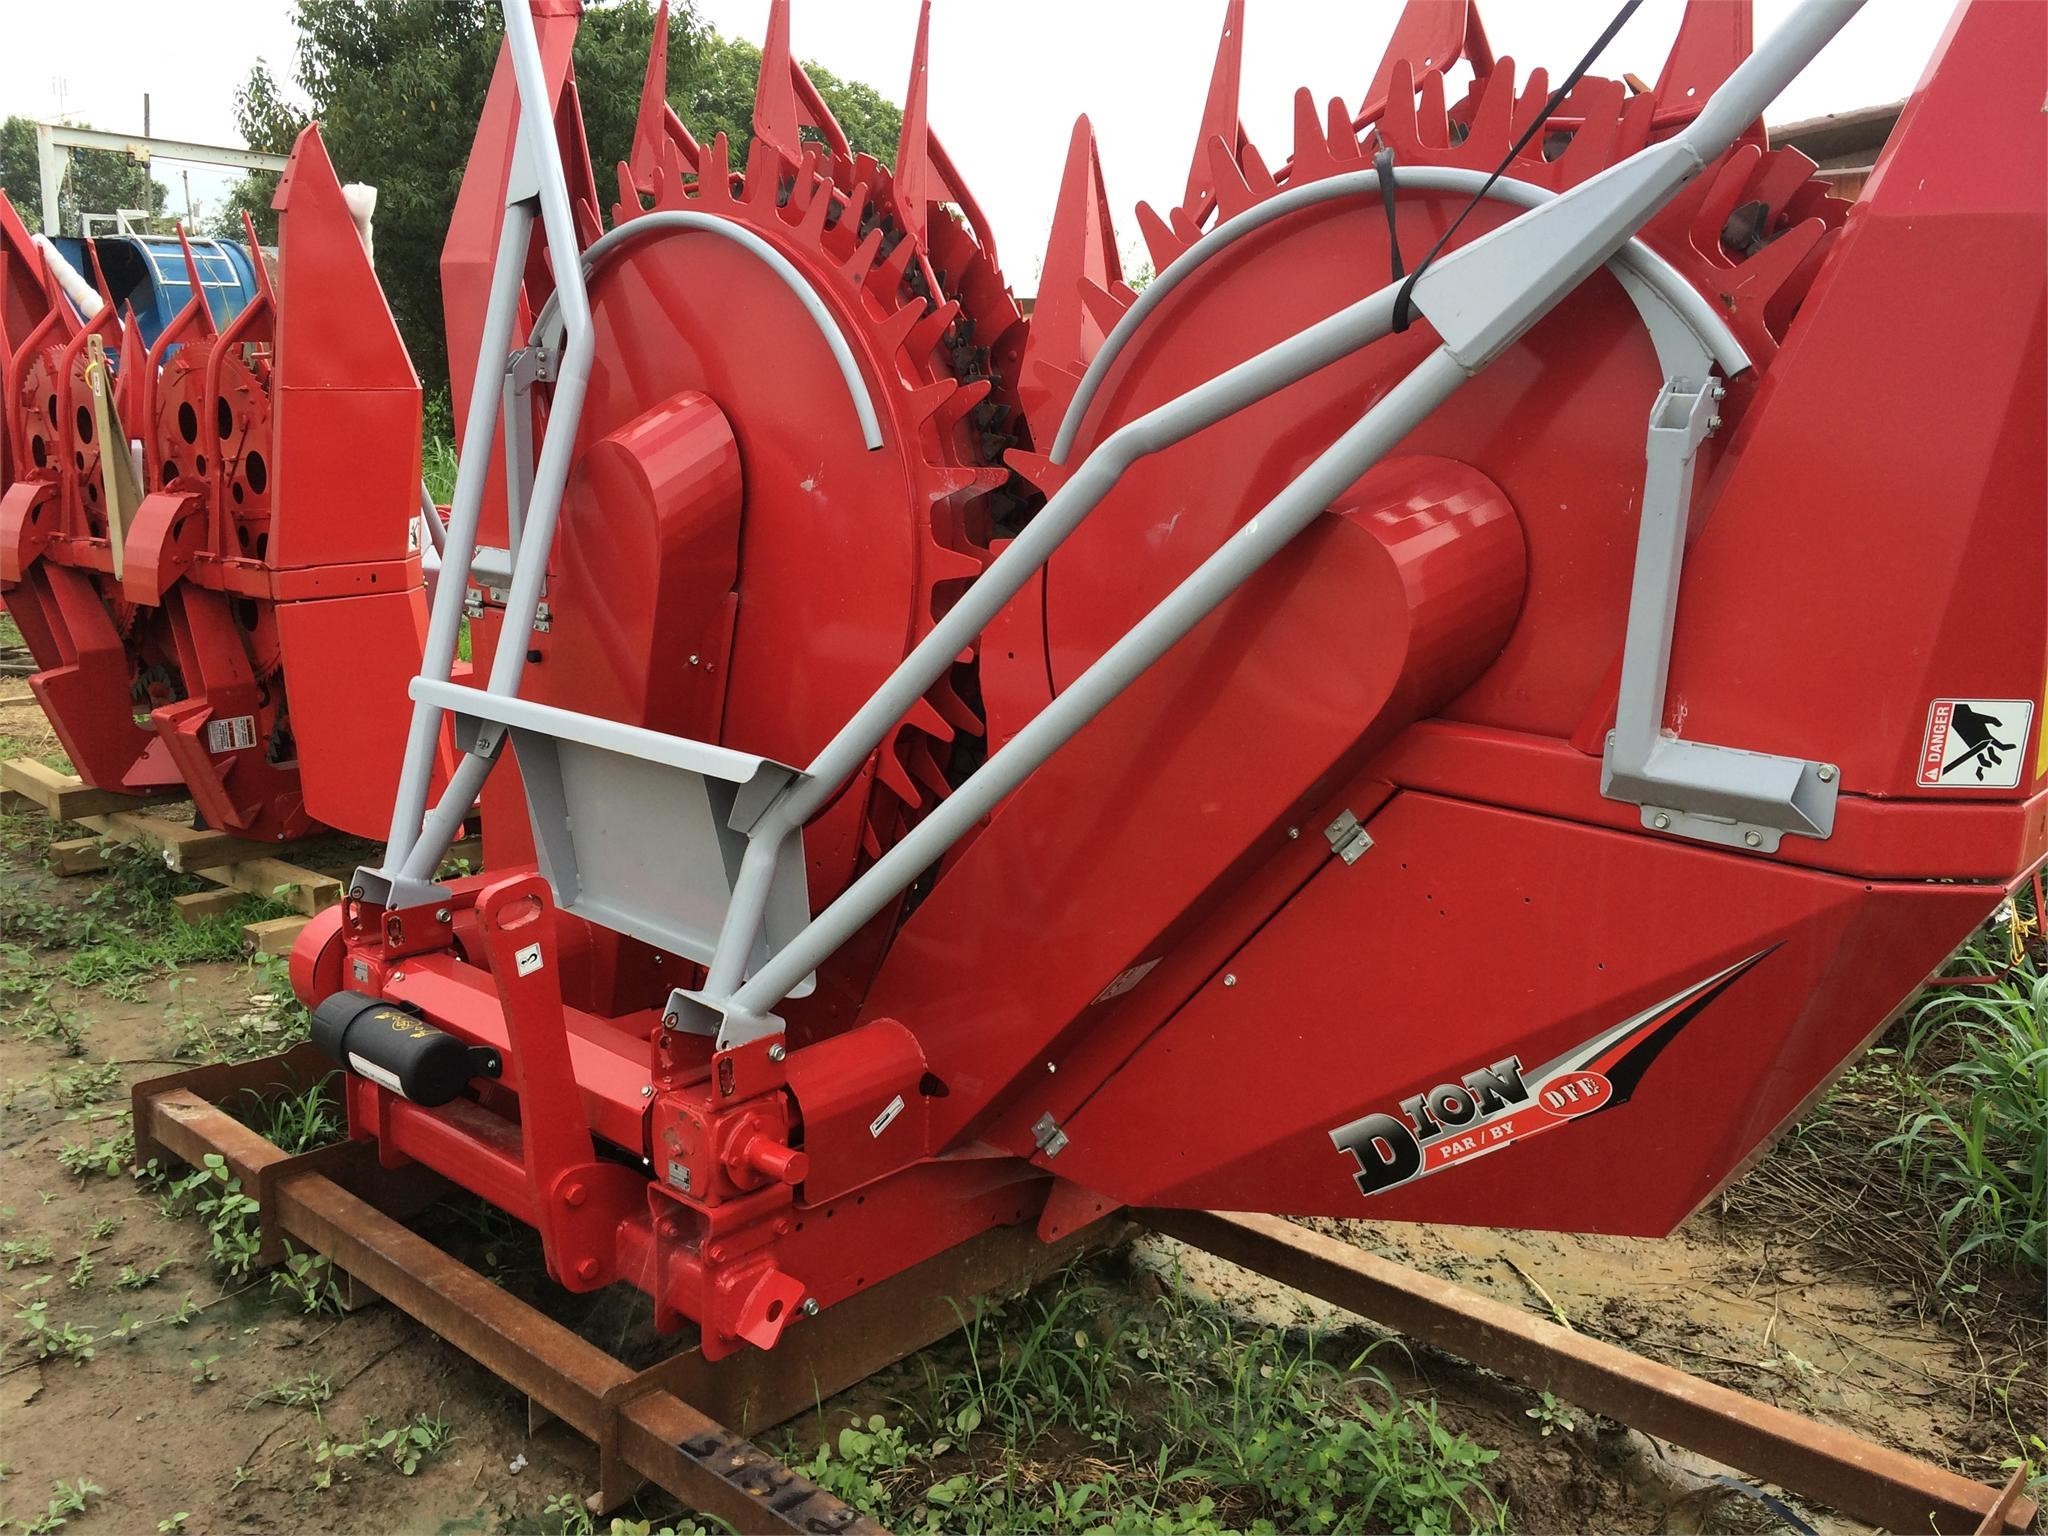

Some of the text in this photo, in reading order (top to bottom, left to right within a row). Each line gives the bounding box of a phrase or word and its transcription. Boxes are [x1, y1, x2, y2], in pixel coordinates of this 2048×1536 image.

[1928, 706, 1950, 762] DANGER
[1328, 1055, 1530, 1197] DION
[1439, 1137, 1477, 1158] PAR
[1489, 1121, 1514, 1139] BY
[1544, 1077, 1601, 1109] DFE
